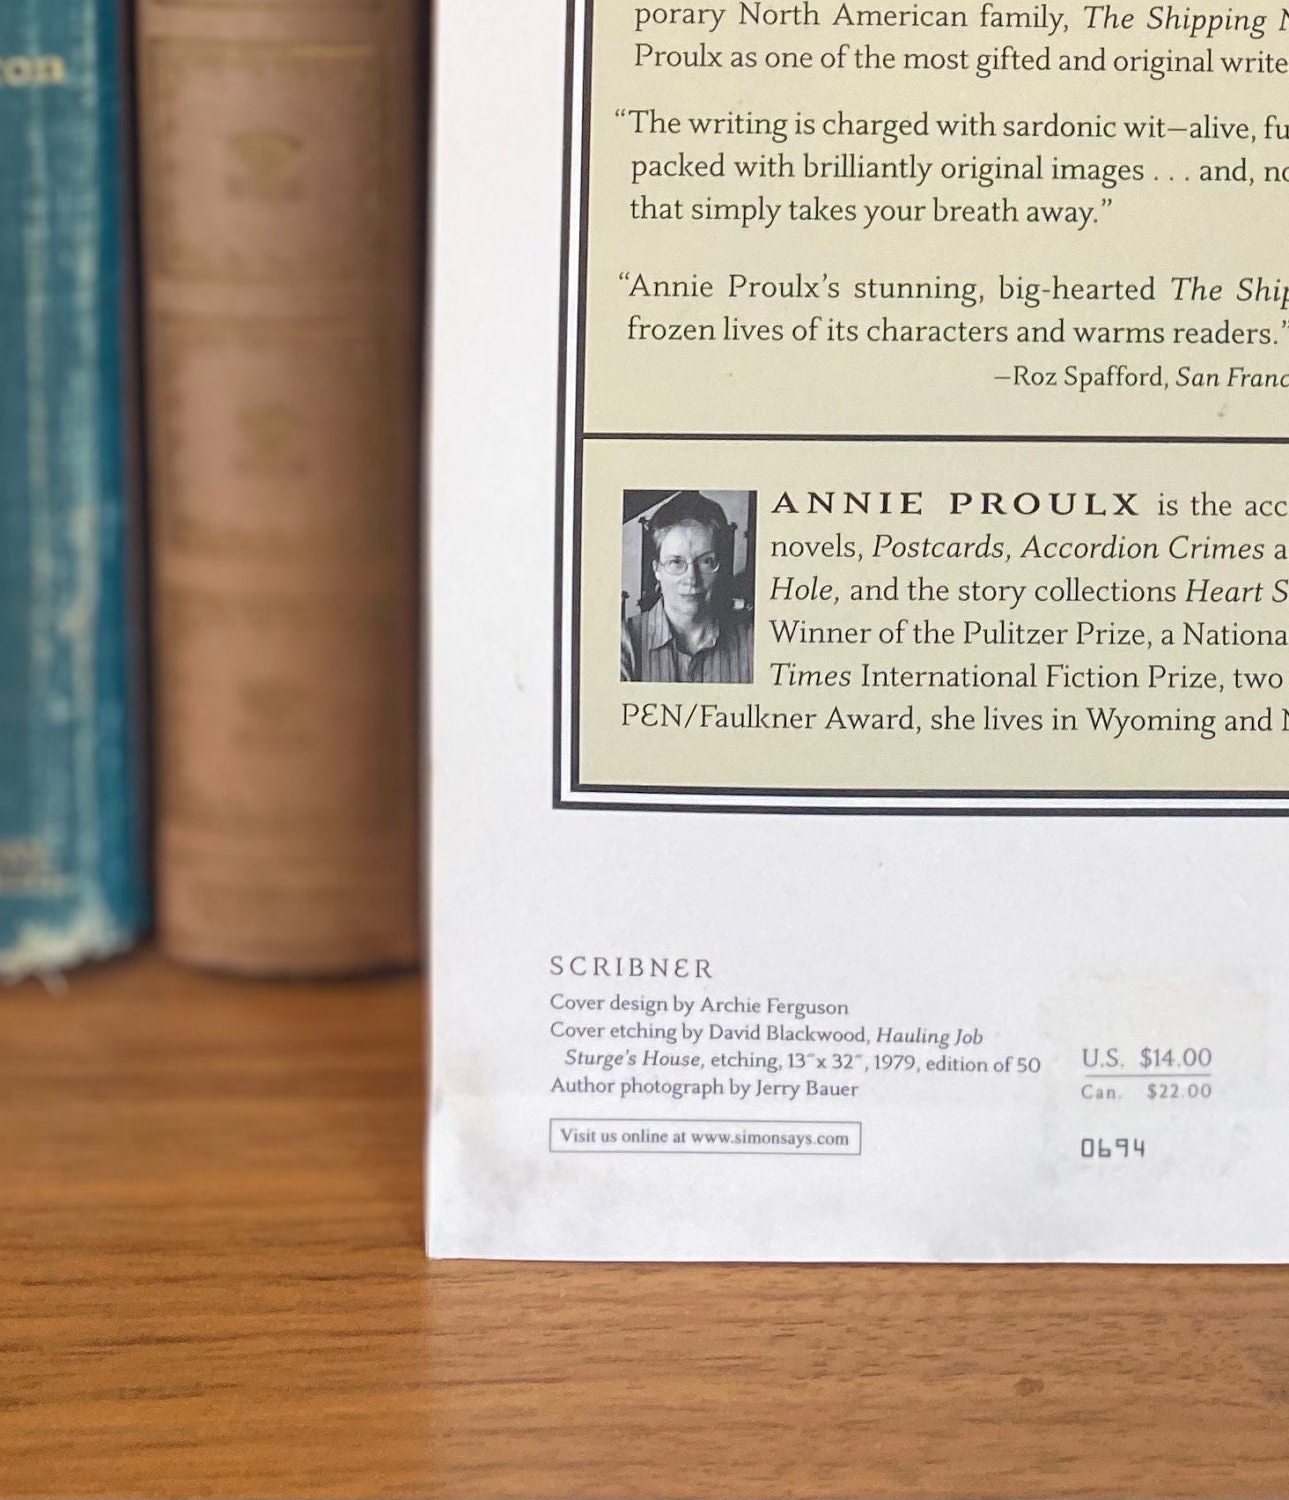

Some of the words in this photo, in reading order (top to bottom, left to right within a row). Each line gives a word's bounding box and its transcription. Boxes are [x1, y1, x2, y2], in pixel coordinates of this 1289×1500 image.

[633, 6, 728, 34] porary
[737, 0, 822, 27] North
[831, 1, 969, 29] American
[978, 2, 1070, 38] family,
[1082, 3, 1135, 31] The
[1145, 4, 1269, 41] Shipping
[628, 193, 685, 221] that
[690, 194, 783, 230] simply
[787, 194, 858, 222] takes
[862, 204, 928, 231] your
[931, 196, 1020, 224] breath
[626, 313, 717, 342] frozen
[722, 314, 785, 342] lives
[791, 314, 824, 343] of
[826, 316, 860, 343] its
[866, 315, 1009, 344] characters
[1015, 316, 1067, 344] and
[1071, 325, 1166, 345] warms
[1063, 363, 1170, 395] Spafford,
[1174, 364, 1221, 388] San
[769, 490, 924, 517] ANNIE
[948, 490, 1141, 518] PROULX
[1157, 491, 1180, 518] is
[1189, 489, 1233, 517] the
[768, 573, 841, 607] Hole,
[849, 574, 900, 602] and
[905, 575, 950, 603] the
[957, 579, 1028, 611] story
[1033, 575, 1178, 604] collections
[1184, 577, 1265, 604] Heart
[823, 704, 922, 736] Award,
[929, 703, 977, 732] she
[982, 704, 1045, 732] lives
[1051, 706, 1080, 732] in
[1084, 706, 1218, 741] Wyoming
[1223, 705, 1274, 733] and
[549, 955, 713, 978] SCRIBNER
[549, 993, 604, 1010] Cover
[609, 993, 668, 1016] design
[673, 994, 695, 1017] by
[700, 996, 761, 1013] Archie
[766, 998, 849, 1019] Ferguson
[550, 1021, 605, 1038] Cover
[610, 1022, 677, 1044] etching
[682, 1023, 703, 1044] by
[709, 1024, 761, 1041] David
[766, 1024, 871, 1045] Blackwood,
[876, 1026, 950, 1049] Hauling
[954, 1028, 984, 1046] Job
[564, 1049, 637, 1071] Sturge's
[642, 1050, 705, 1069] House,
[711, 1051, 783, 1073] etching,
[874, 1054, 921, 1073] 1979,
[926, 1055, 988, 1073] edition
[993, 1056, 1013, 1073] of
[1017, 1057, 1042, 1074] 50
[1082, 1047, 1125, 1068] U.S.
[1139, 1046, 1212, 1069] $14.00
[550, 1076, 616, 1093] Author
[620, 1077, 724, 1100] photograph
[729, 1078, 751, 1100] by
[755, 1079, 801, 1101] Jerry
[806, 1080, 859, 1097] Bauer
[1081, 1083, 1122, 1100] Can.
[1146, 1082, 1212, 1100] $22.00
[560, 1127, 596, 1143] Visit
[601, 1131, 617, 1144] us
[621, 1129, 668, 1144] online
[673, 1131, 686, 1145] at
[691, 1129, 849, 1149] www.simonsays.com
[1081, 1138, 1145, 1158] 0694
